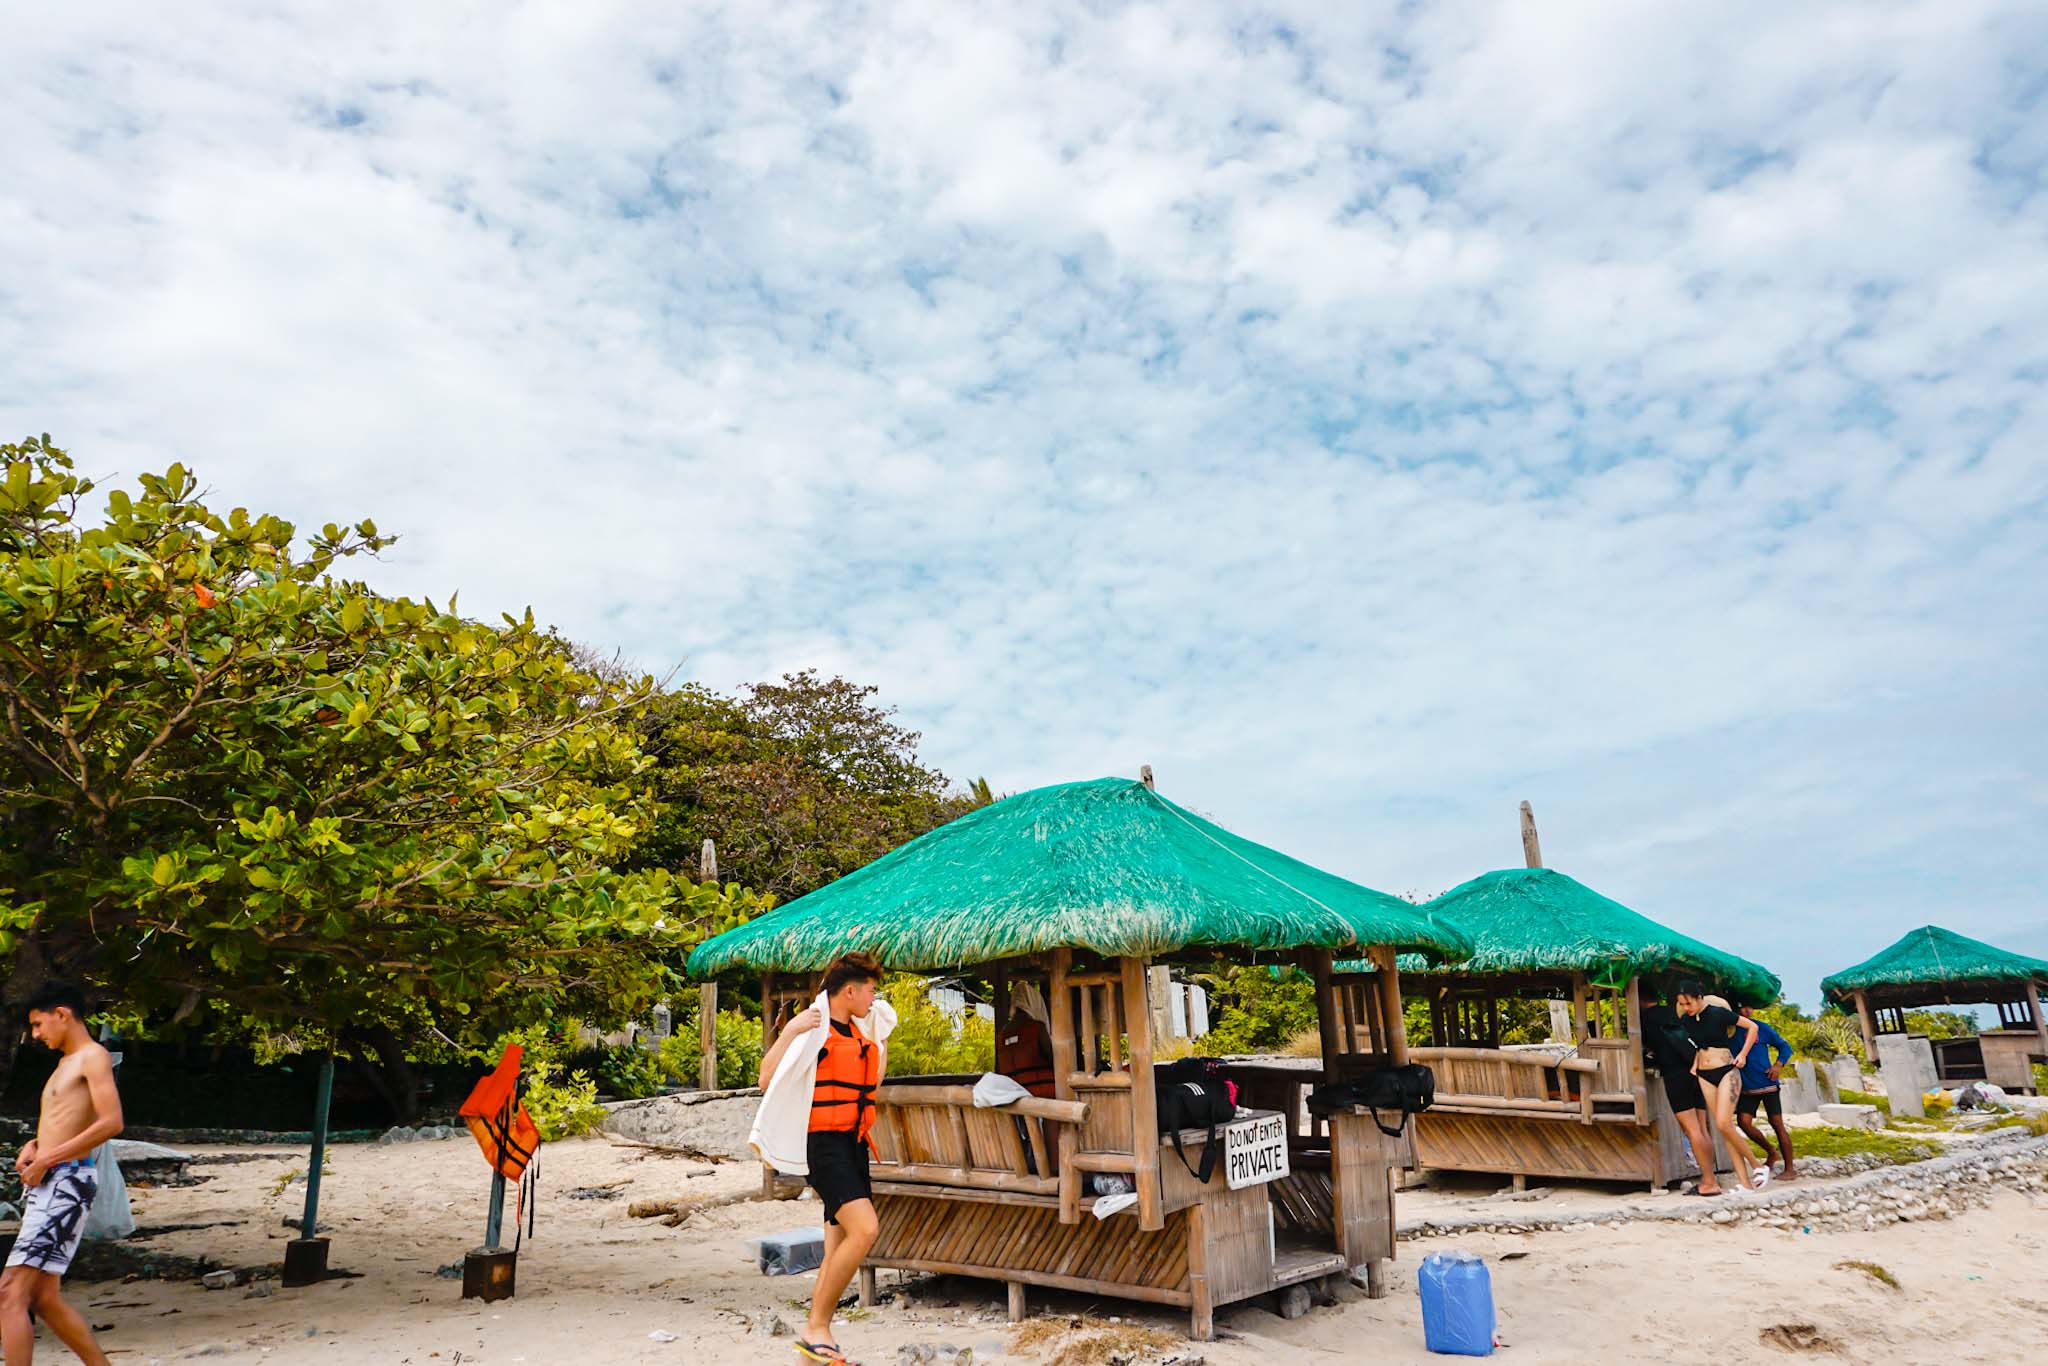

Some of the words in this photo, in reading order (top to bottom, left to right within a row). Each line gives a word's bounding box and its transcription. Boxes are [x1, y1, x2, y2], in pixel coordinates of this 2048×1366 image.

[1230, 1130, 1242, 1148] DO
[1243, 1125, 1257, 1146] NOT
[1260, 1121, 1283, 1141] ENTER
[1231, 1144, 1282, 1181] PRIVATE
